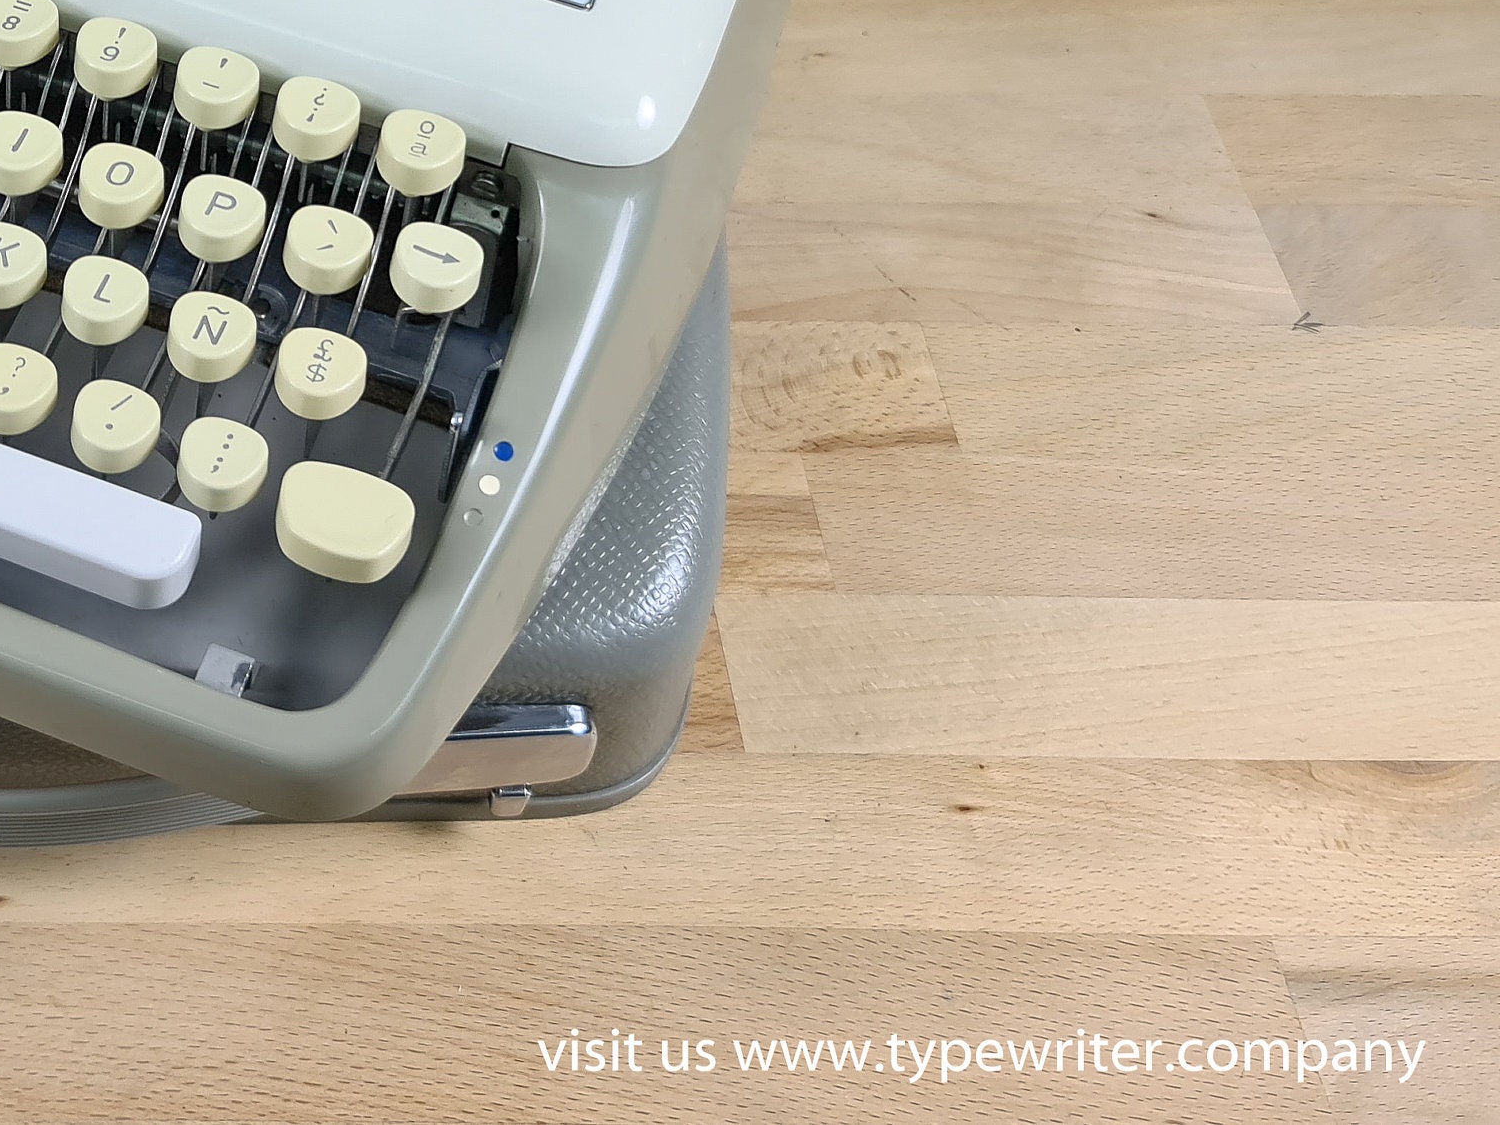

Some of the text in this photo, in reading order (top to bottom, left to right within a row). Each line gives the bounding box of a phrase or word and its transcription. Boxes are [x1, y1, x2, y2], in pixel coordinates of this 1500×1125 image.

[1, 15, 21, 31] 8
[99, 45, 121, 63] 9
[11, 128, 29, 153] I
[105, 161, 135, 186] O
[204, 191, 237, 216] P
[93, 273, 111, 304] L
[192, 306, 230, 346] Ñ
[312, 339, 334, 363] £
[11, 356, 26, 378] ?
[305, 362, 329, 384] $
